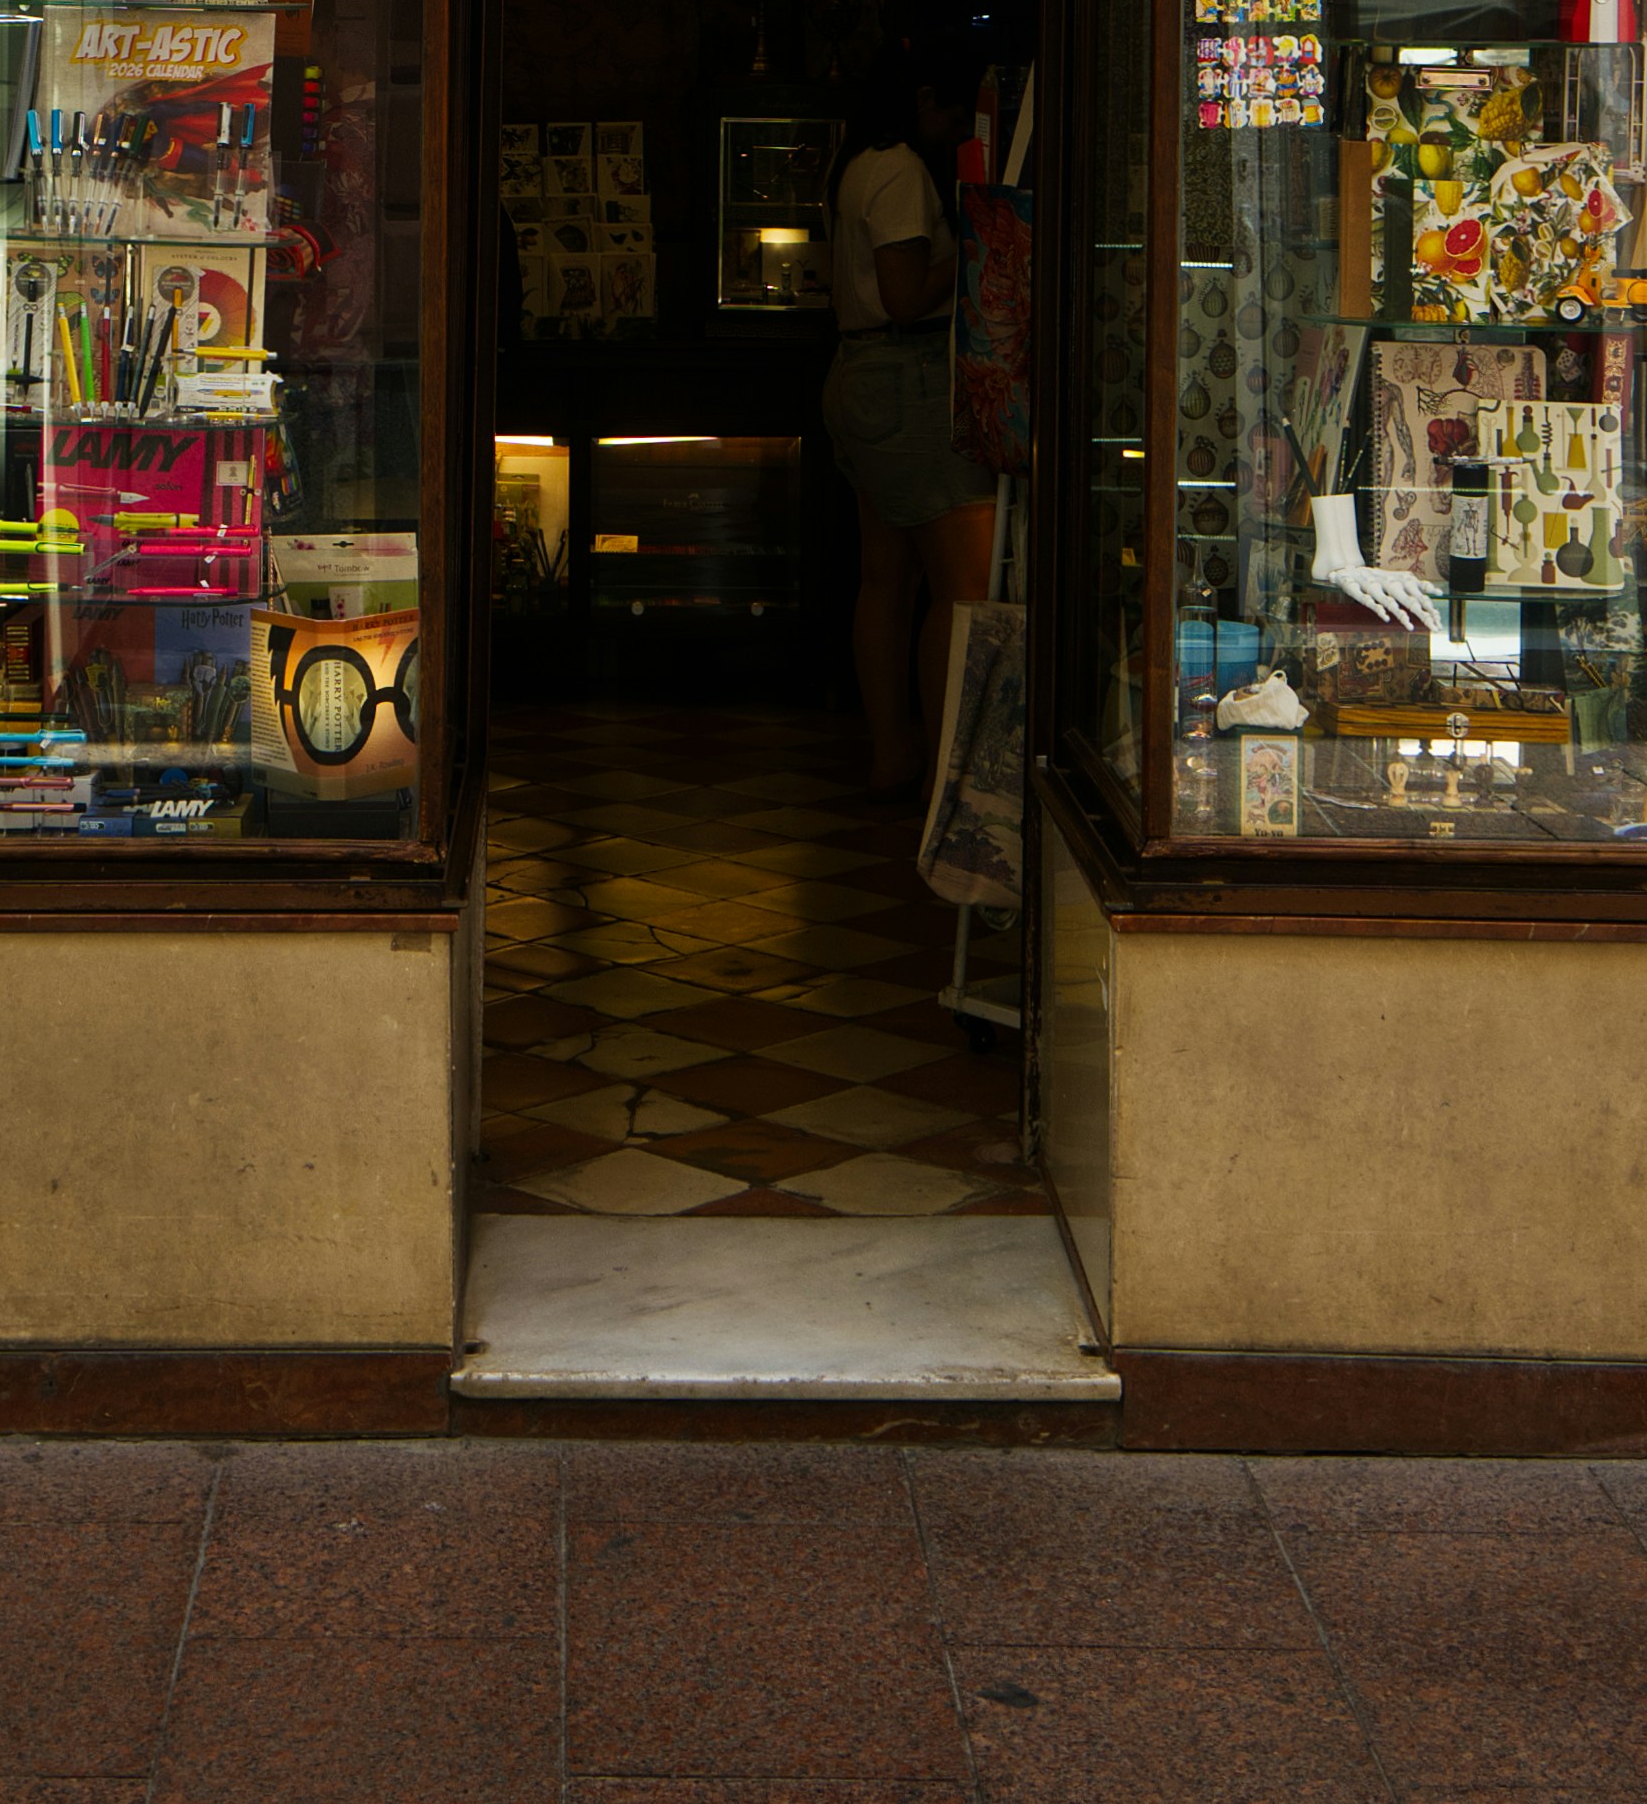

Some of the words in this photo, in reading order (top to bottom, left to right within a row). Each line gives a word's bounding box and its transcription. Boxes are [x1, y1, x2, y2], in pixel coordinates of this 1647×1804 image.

[75, 22, 243, 65] ART-ASTIC
[109, 62, 144, 78] 2026
[145, 63, 205, 80] CALENDAR
[47, 429, 200, 473] LAMY
[334, 564, 371, 573] Tombow
[181, 608, 212, 630] Harry
[212, 607, 244, 629] Potter
[333, 661, 342, 704] HARRY
[333, 706, 342, 752] POTTER
[150, 799, 216, 819] LAMY
